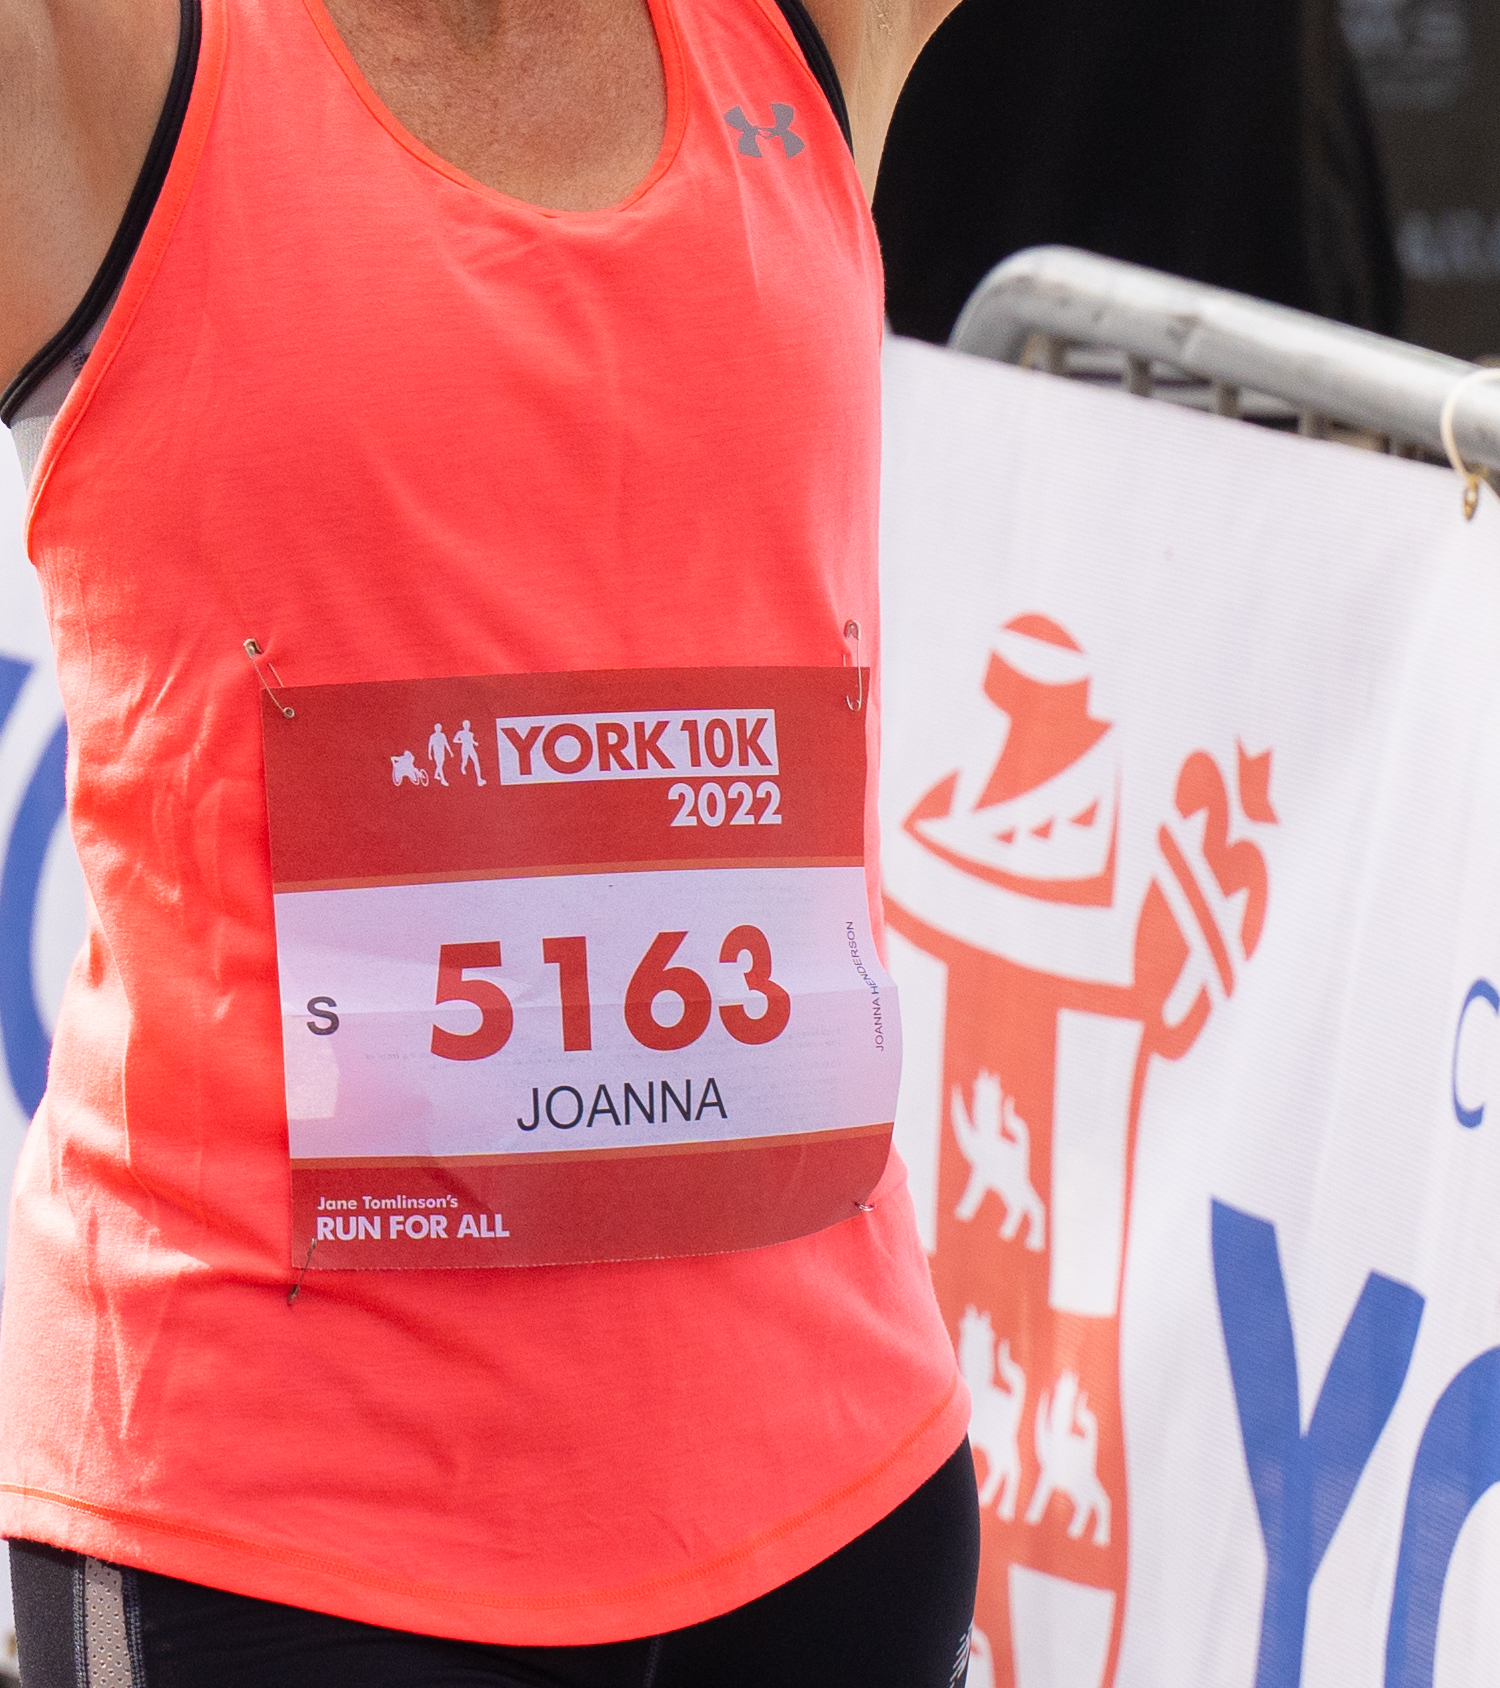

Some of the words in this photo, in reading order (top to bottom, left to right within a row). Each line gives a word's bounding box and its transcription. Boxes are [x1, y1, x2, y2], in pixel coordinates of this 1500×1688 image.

[502, 720, 676, 775] YORK
[681, 717, 775, 770] 10K
[667, 782, 783, 827] 2022
[845, 921, 879, 995] HENDERSON
[306, 996, 340, 1036] S
[430, 925, 792, 1062] 5163
[871, 997, 884, 1052] JOANNA
[516, 1077, 728, 1132] JOANNA
[316, 1215, 382, 1241] RUN
[389, 1215, 448, 1240] FOR
[456, 1213, 510, 1238] ALL
[317, 1196, 358, 1211] Jane
[362, 1195, 459, 1210] Tomlinson's
